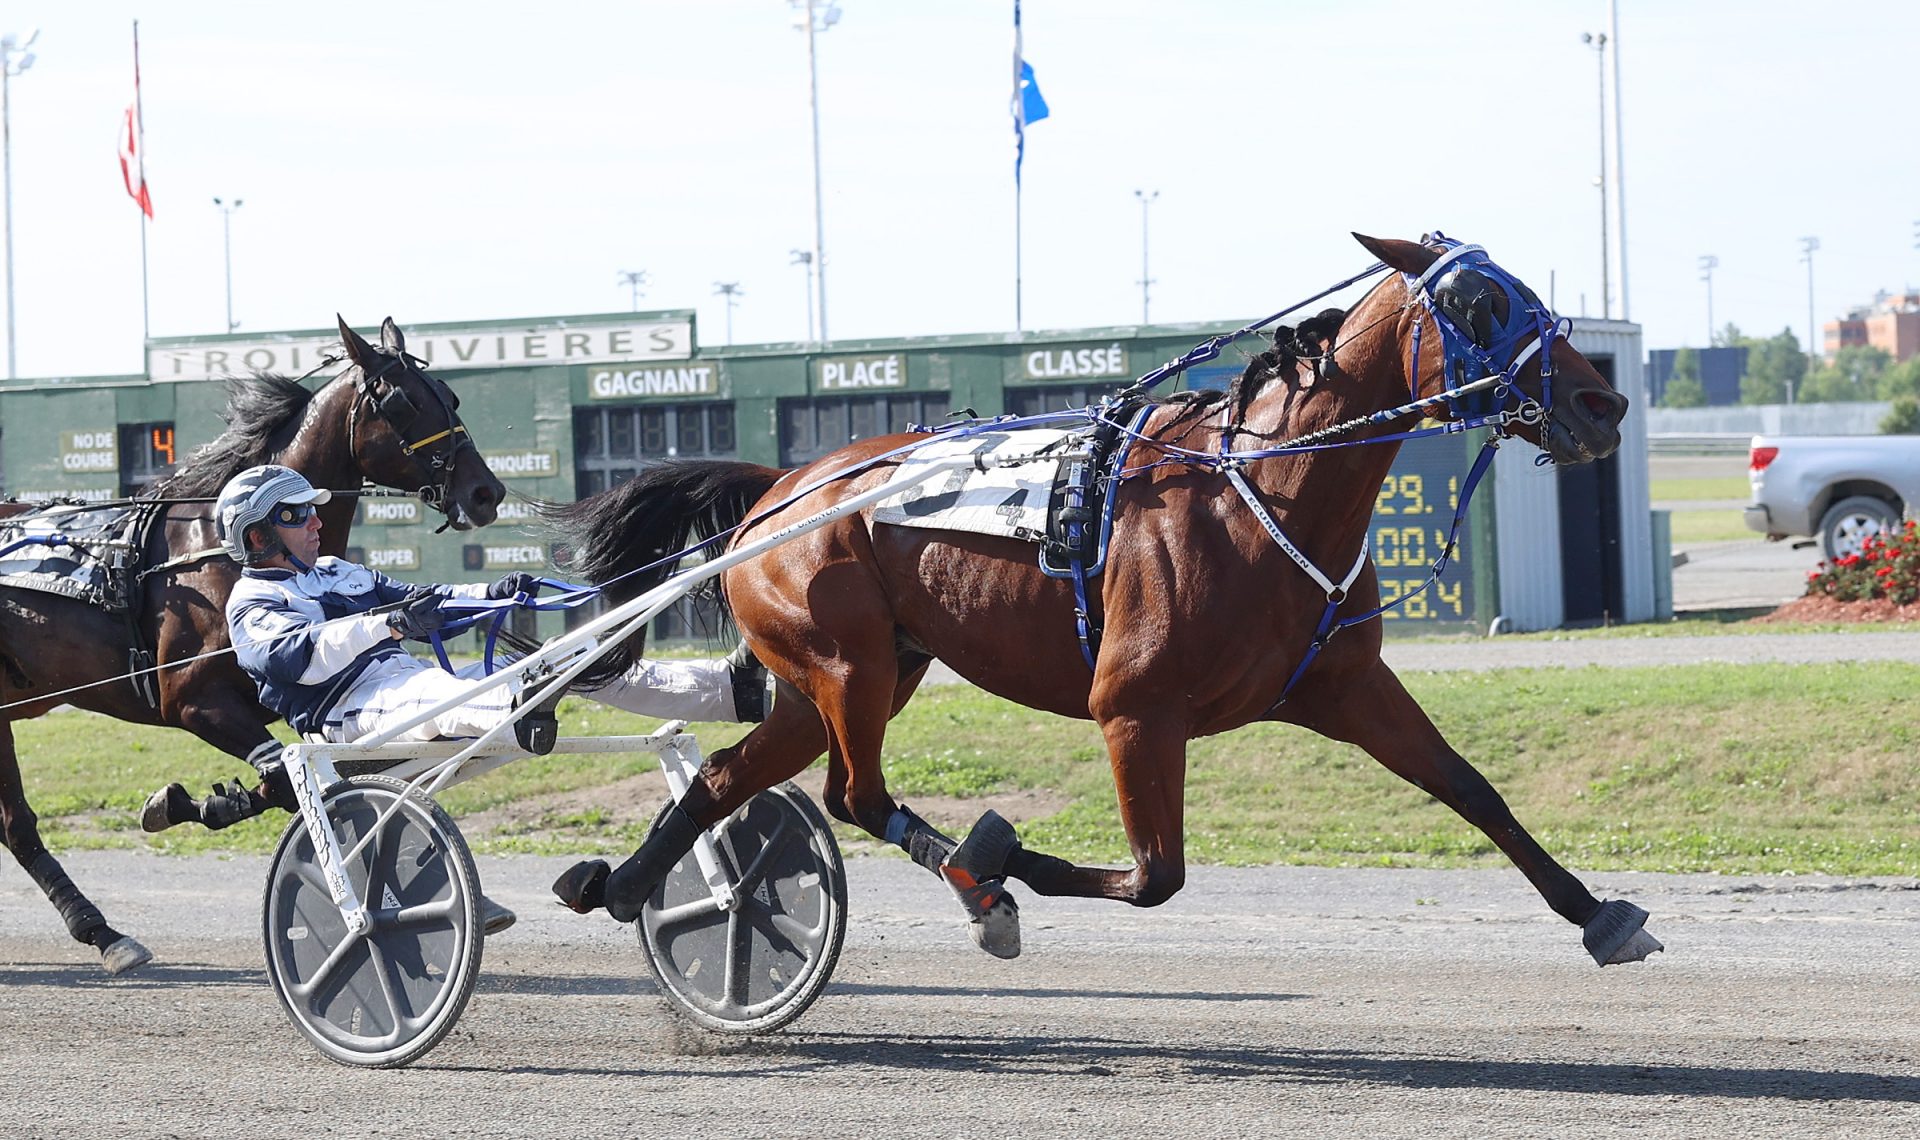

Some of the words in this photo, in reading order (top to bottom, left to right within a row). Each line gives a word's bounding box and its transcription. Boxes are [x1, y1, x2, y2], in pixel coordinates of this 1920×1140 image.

[424, 328, 676, 362] IVIÈRES
[821, 354, 899, 388] PLACÉ
[1026, 343, 1122, 377] CLASSÉ
[593, 366, 711, 397] GAGNANT
[73, 433, 94, 448] NO
[95, 432, 113, 448] DE
[153, 428, 175, 465] 4
[63, 451, 114, 469] COURSE
[489, 453, 551, 471] ENQUÊTE
[367, 503, 417, 519] PHOTO
[1248, 496, 1283, 542] ECURIE
[1282, 542, 1310, 570] MEN
[368, 549, 415, 566] SUPER
[486, 544, 545, 564] TRIFECTA
